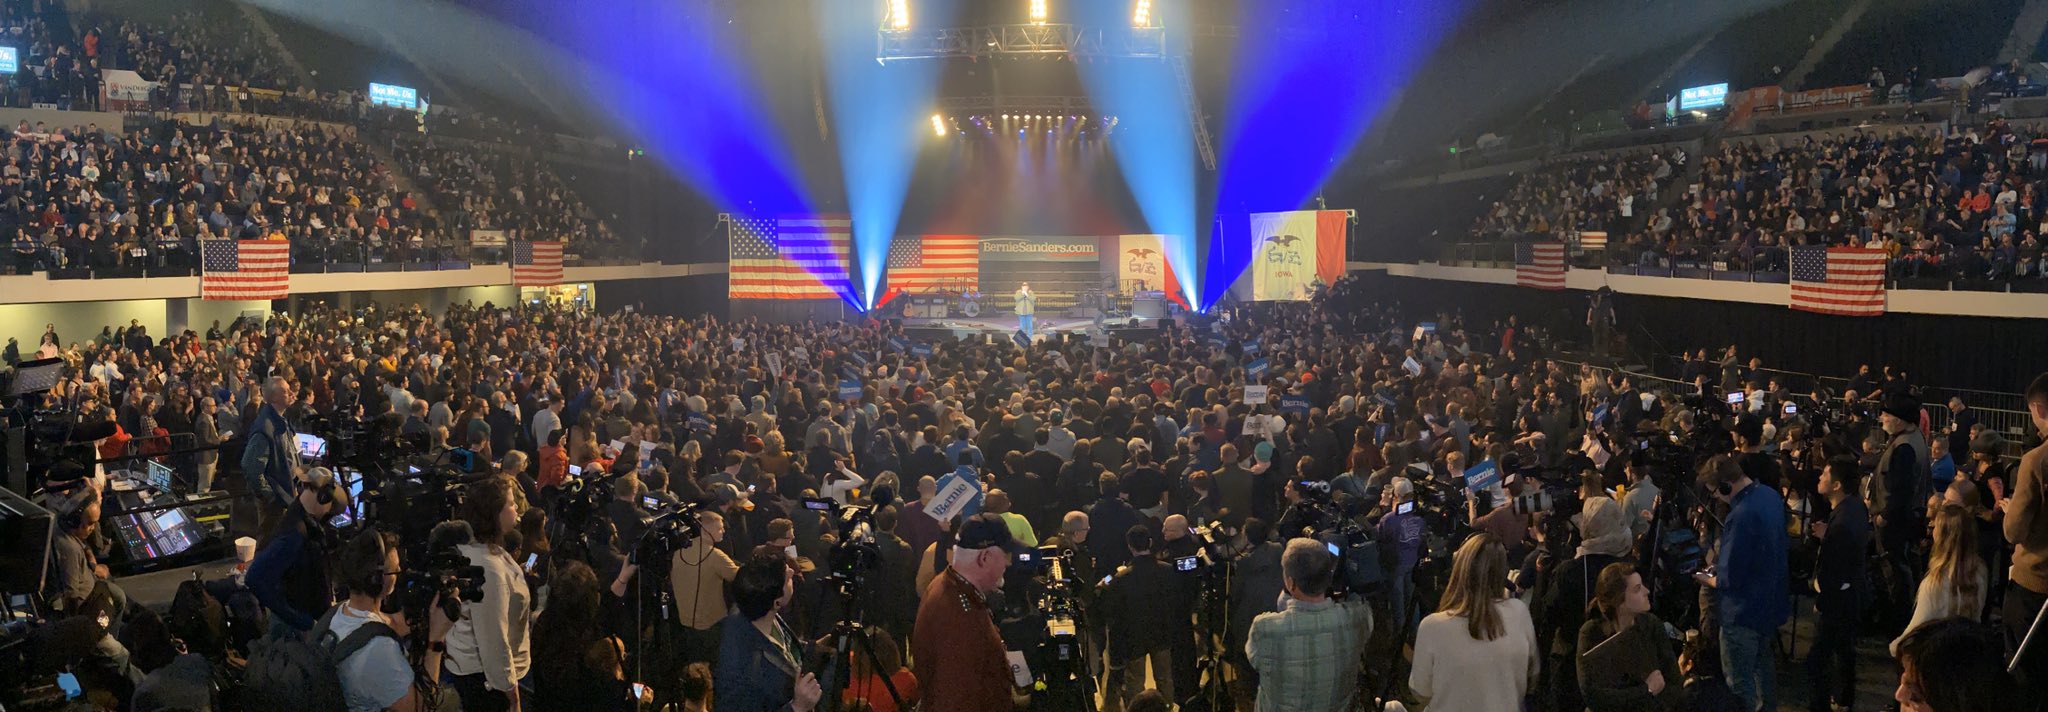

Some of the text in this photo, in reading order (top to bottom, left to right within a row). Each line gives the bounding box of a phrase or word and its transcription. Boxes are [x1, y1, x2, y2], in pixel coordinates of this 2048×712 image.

[372, 85, 413, 99] Not Me. Us.
[1684, 86, 1724, 99] Not Me. Us.
[983, 241, 1094, 253] BernieSanders.com
[1282, 400, 1309, 408] Bernie
[1467, 467, 1495, 486] Bernie
[932, 483, 967, 516] Bernie
